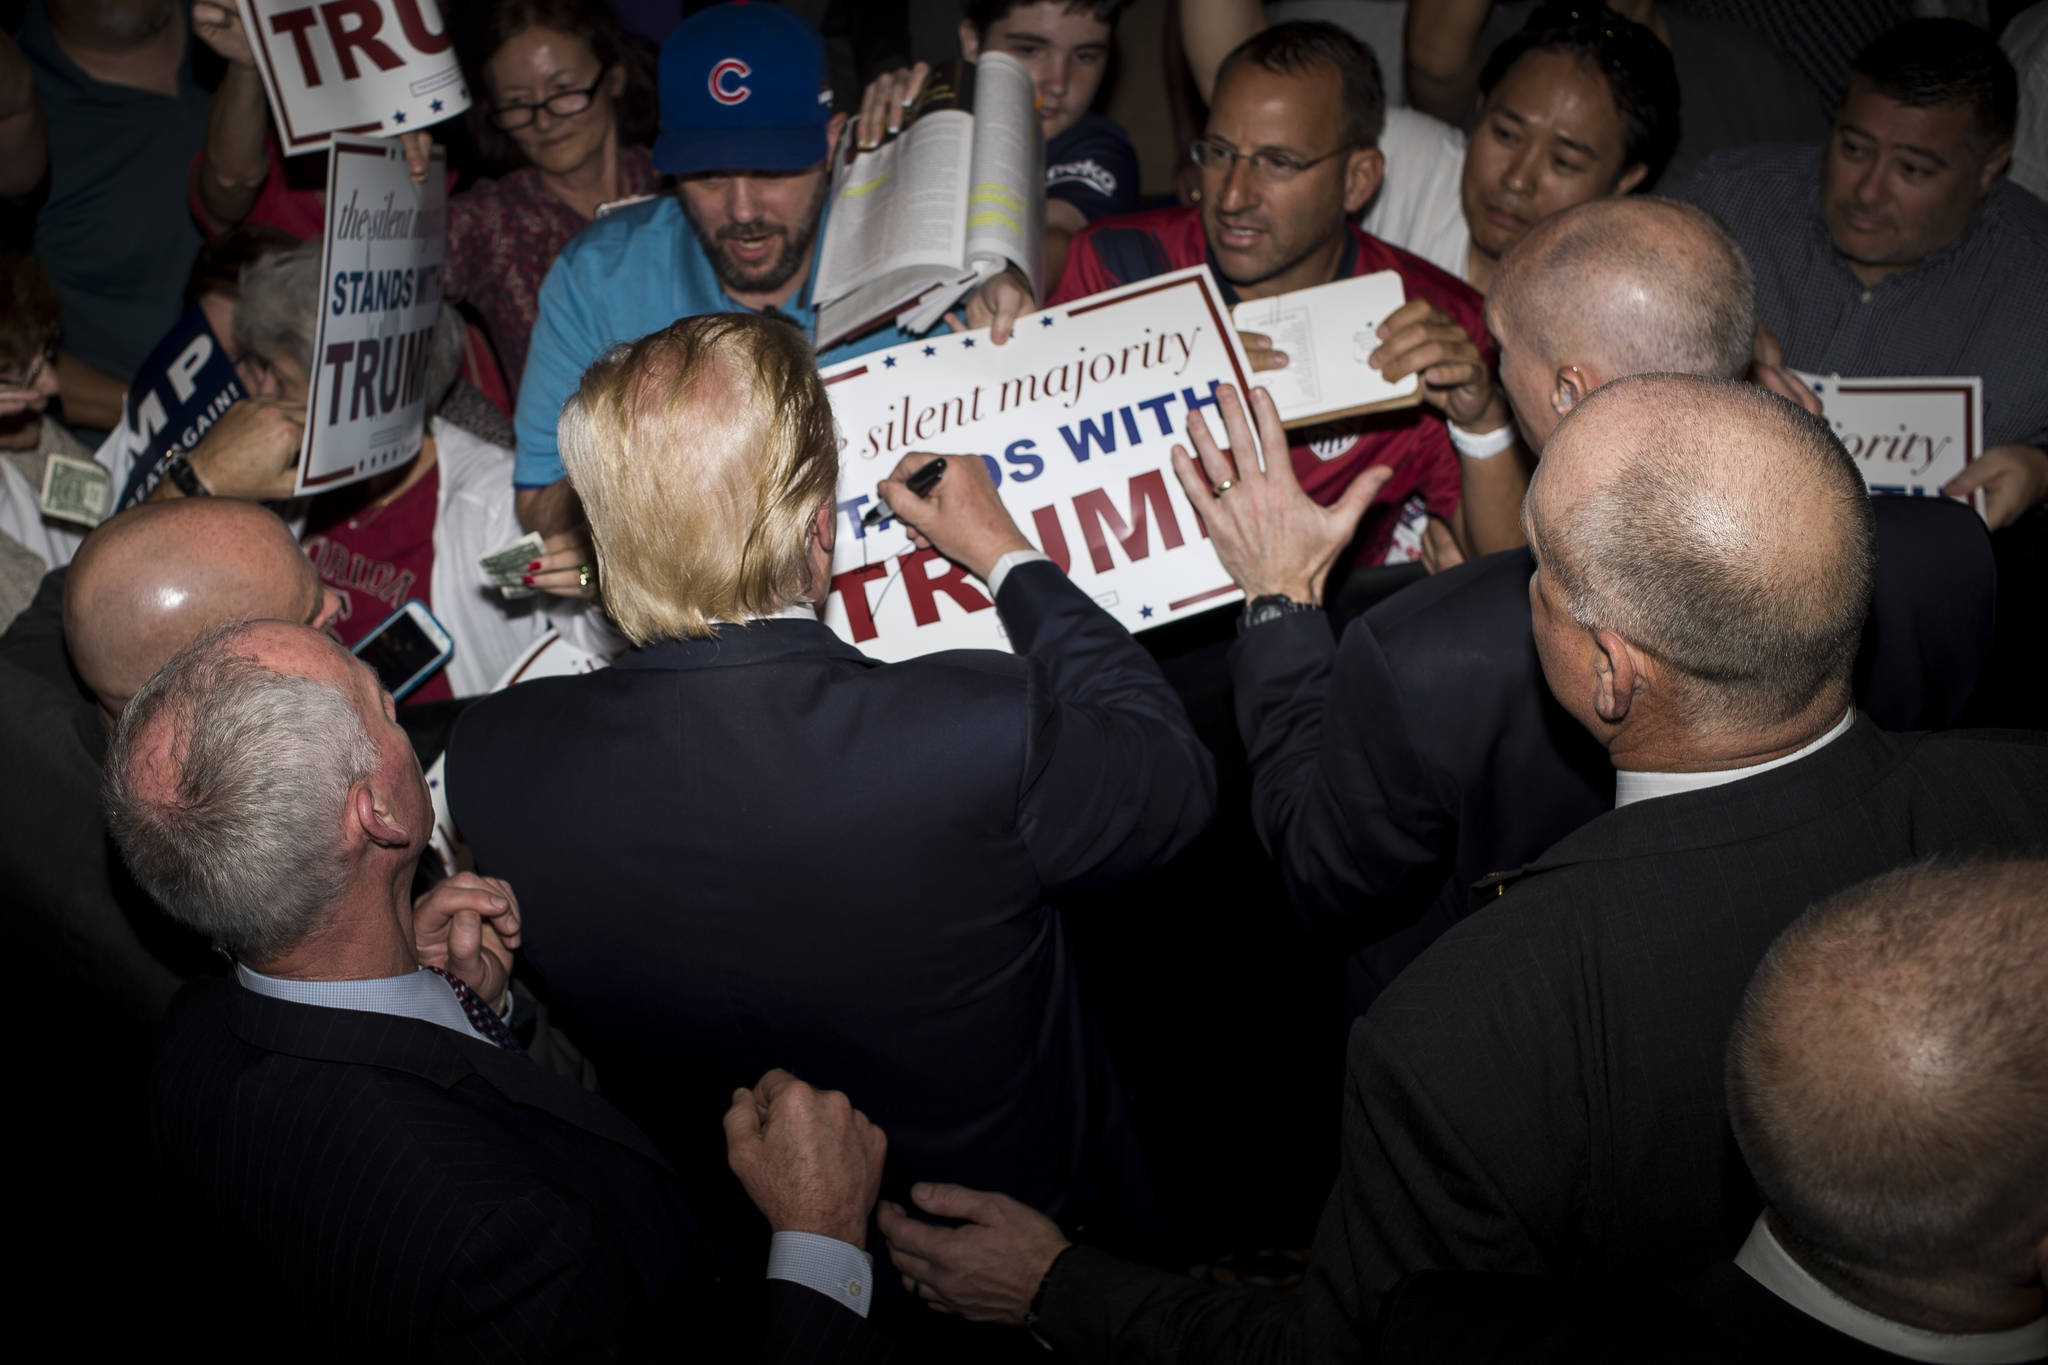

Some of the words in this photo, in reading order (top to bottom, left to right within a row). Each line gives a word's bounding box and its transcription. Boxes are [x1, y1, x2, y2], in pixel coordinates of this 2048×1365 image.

[707, 58, 752, 106] C
[337, 189, 367, 240] the
[368, 191, 414, 241] silent
[331, 267, 414, 316] STANDS
[860, 386, 985, 460] silent
[1000, 327, 1202, 412] majority
[1058, 379, 1223, 463] WITH
[1836, 422, 1952, 477] ority
[828, 449, 1240, 643] TRM
